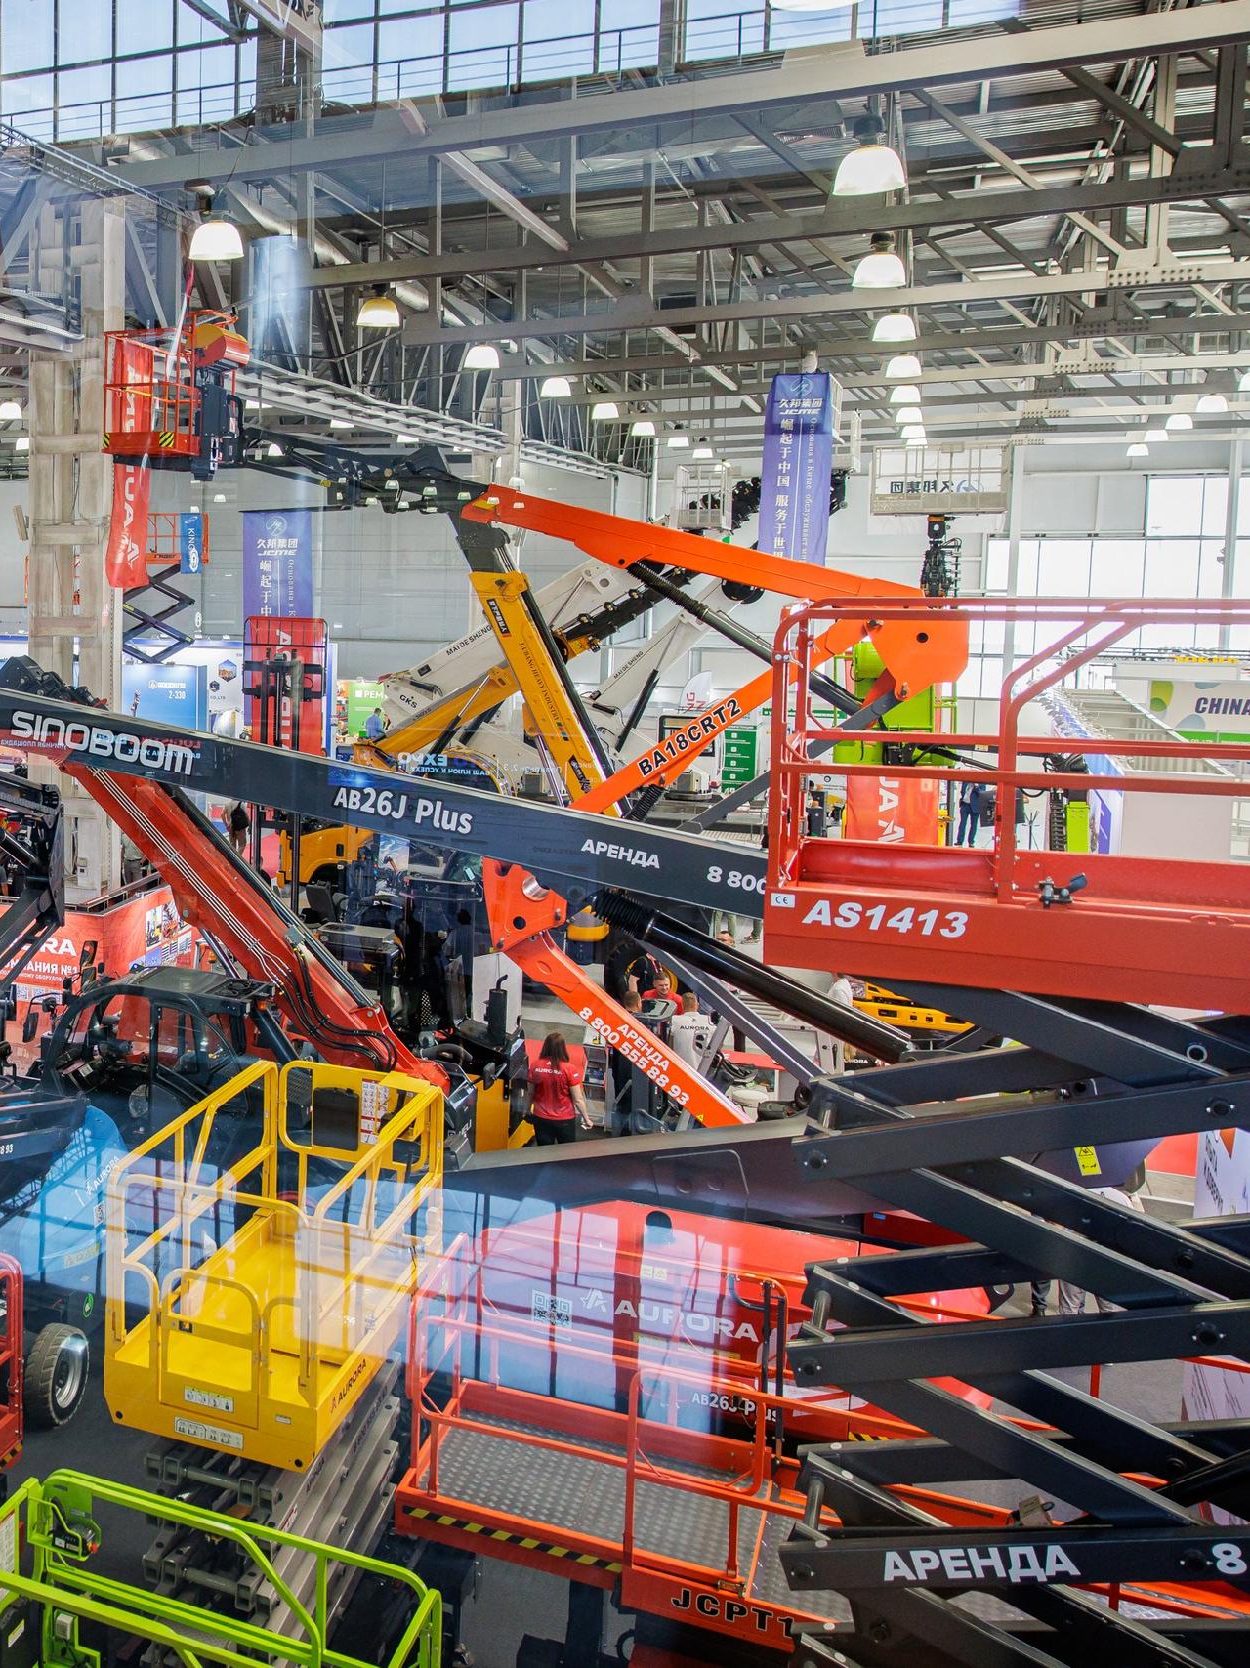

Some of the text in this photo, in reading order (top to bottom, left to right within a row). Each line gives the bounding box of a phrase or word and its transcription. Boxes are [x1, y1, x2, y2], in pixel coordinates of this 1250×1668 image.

[778, 398, 822, 409] 久邦集团
[776, 418, 794, 487] 崛起于中国
[257, 538, 298, 549] 久邦集团
[363, 690, 385, 698] РЕМ
[399, 694, 418, 709] GKS
[11, 711, 193, 775] SINOBOOM
[637, 697, 742, 777] BA18CRT2
[334, 785, 473, 835] AB26J Plus
[580, 838, 660, 869] АРЕНДА
[706, 865, 766, 895] 8 800
[802, 899, 968, 939] AS1413
[578, 1006, 691, 1106] 8 800 555 88 93
[616, 1023, 670, 1072] АРЕНДА
[5, 1144, 14, 1153] 93
[613, 1299, 760, 1343] AURORA
[337, 1358, 367, 1404] AURORA
[883, 1544, 1081, 1583] АРЕНДА
[1211, 1542, 1248, 1575] 8
